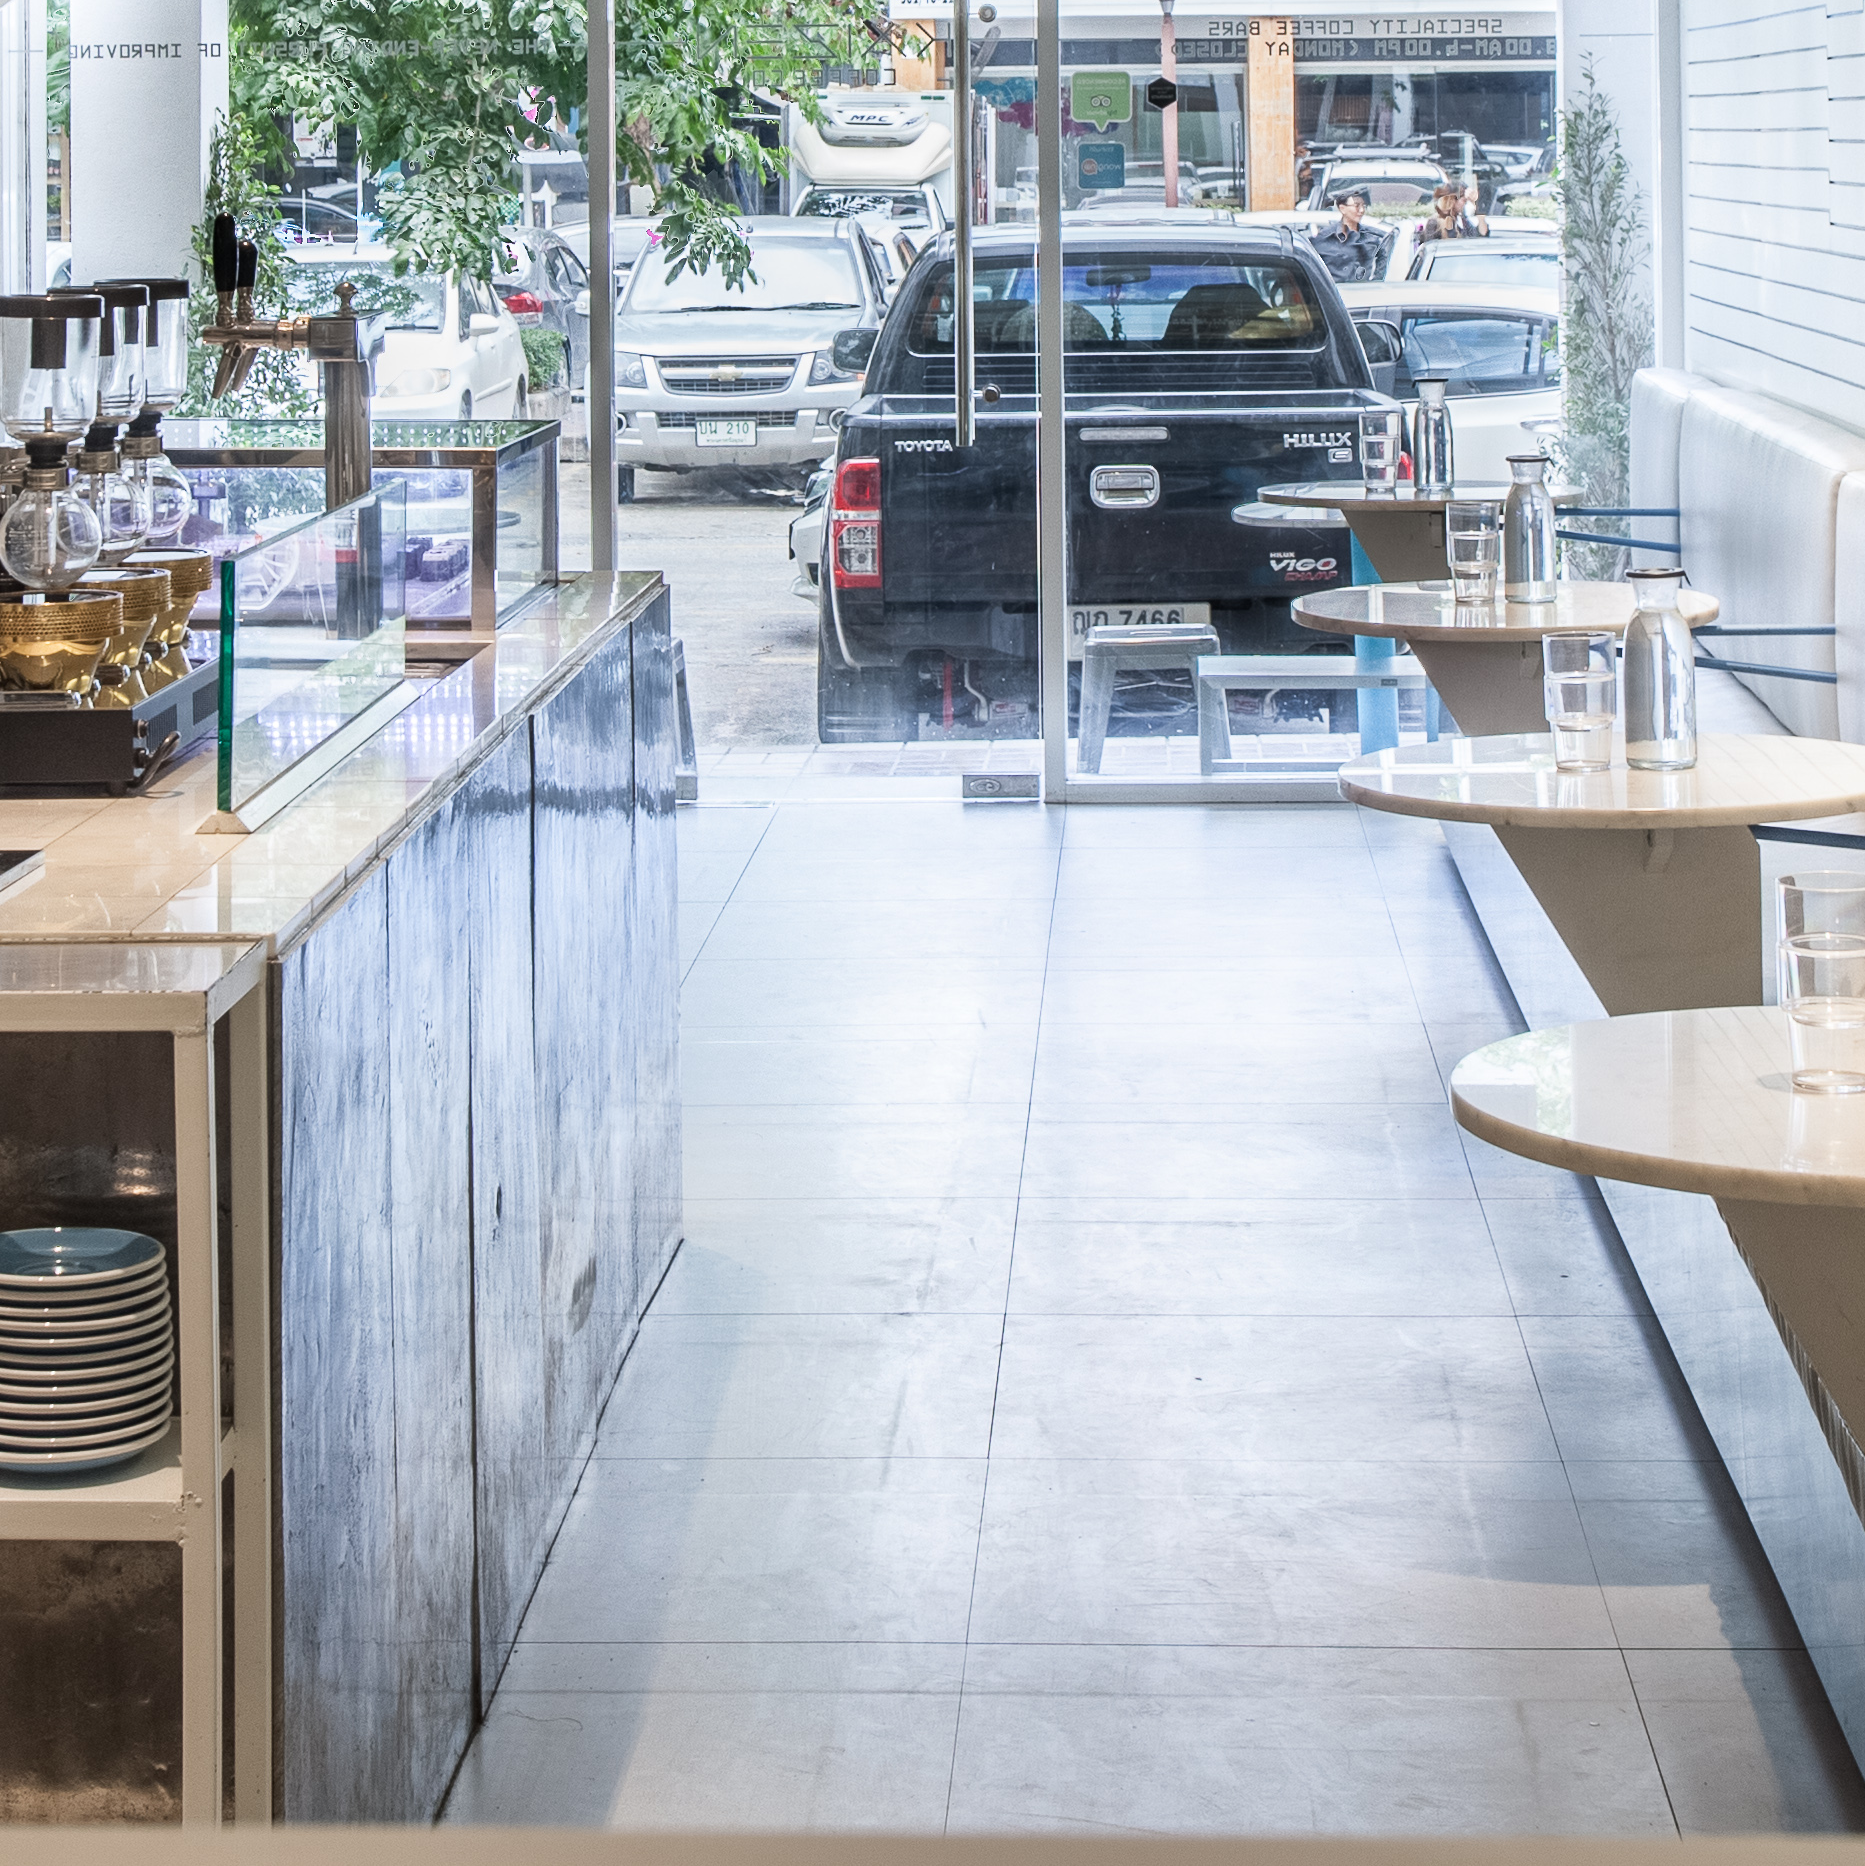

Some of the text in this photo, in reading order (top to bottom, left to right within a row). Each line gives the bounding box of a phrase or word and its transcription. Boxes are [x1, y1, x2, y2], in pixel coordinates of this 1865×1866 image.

[850, 114, 889, 123] MPC
[726, 421, 750, 435] 210
[894, 439, 954, 453] TOYOTA
[1283, 432, 1353, 448] HILUX
